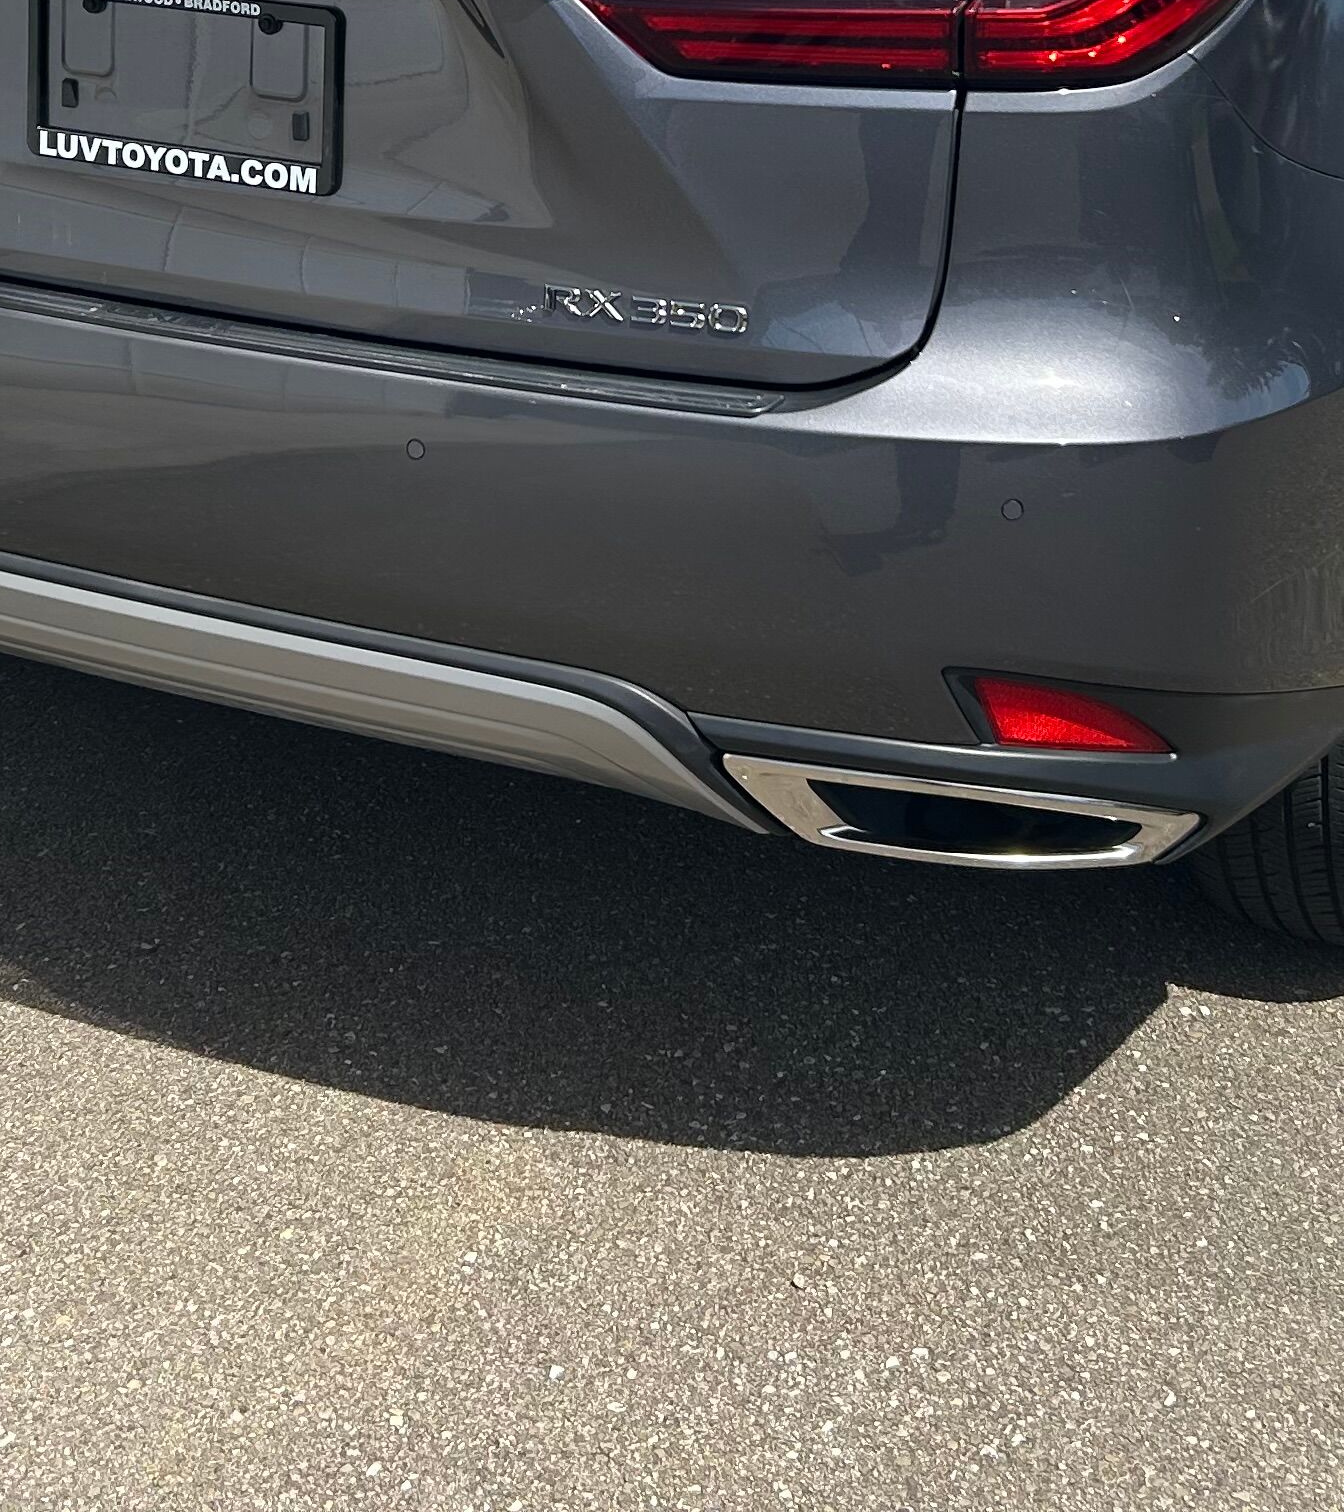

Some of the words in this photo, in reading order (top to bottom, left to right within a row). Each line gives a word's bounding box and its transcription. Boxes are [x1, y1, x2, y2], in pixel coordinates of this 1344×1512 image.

[39, 130, 318, 194] LUVTOYOTA.COM
[543, 284, 624, 321] RX
[630, 294, 750, 334] 350
